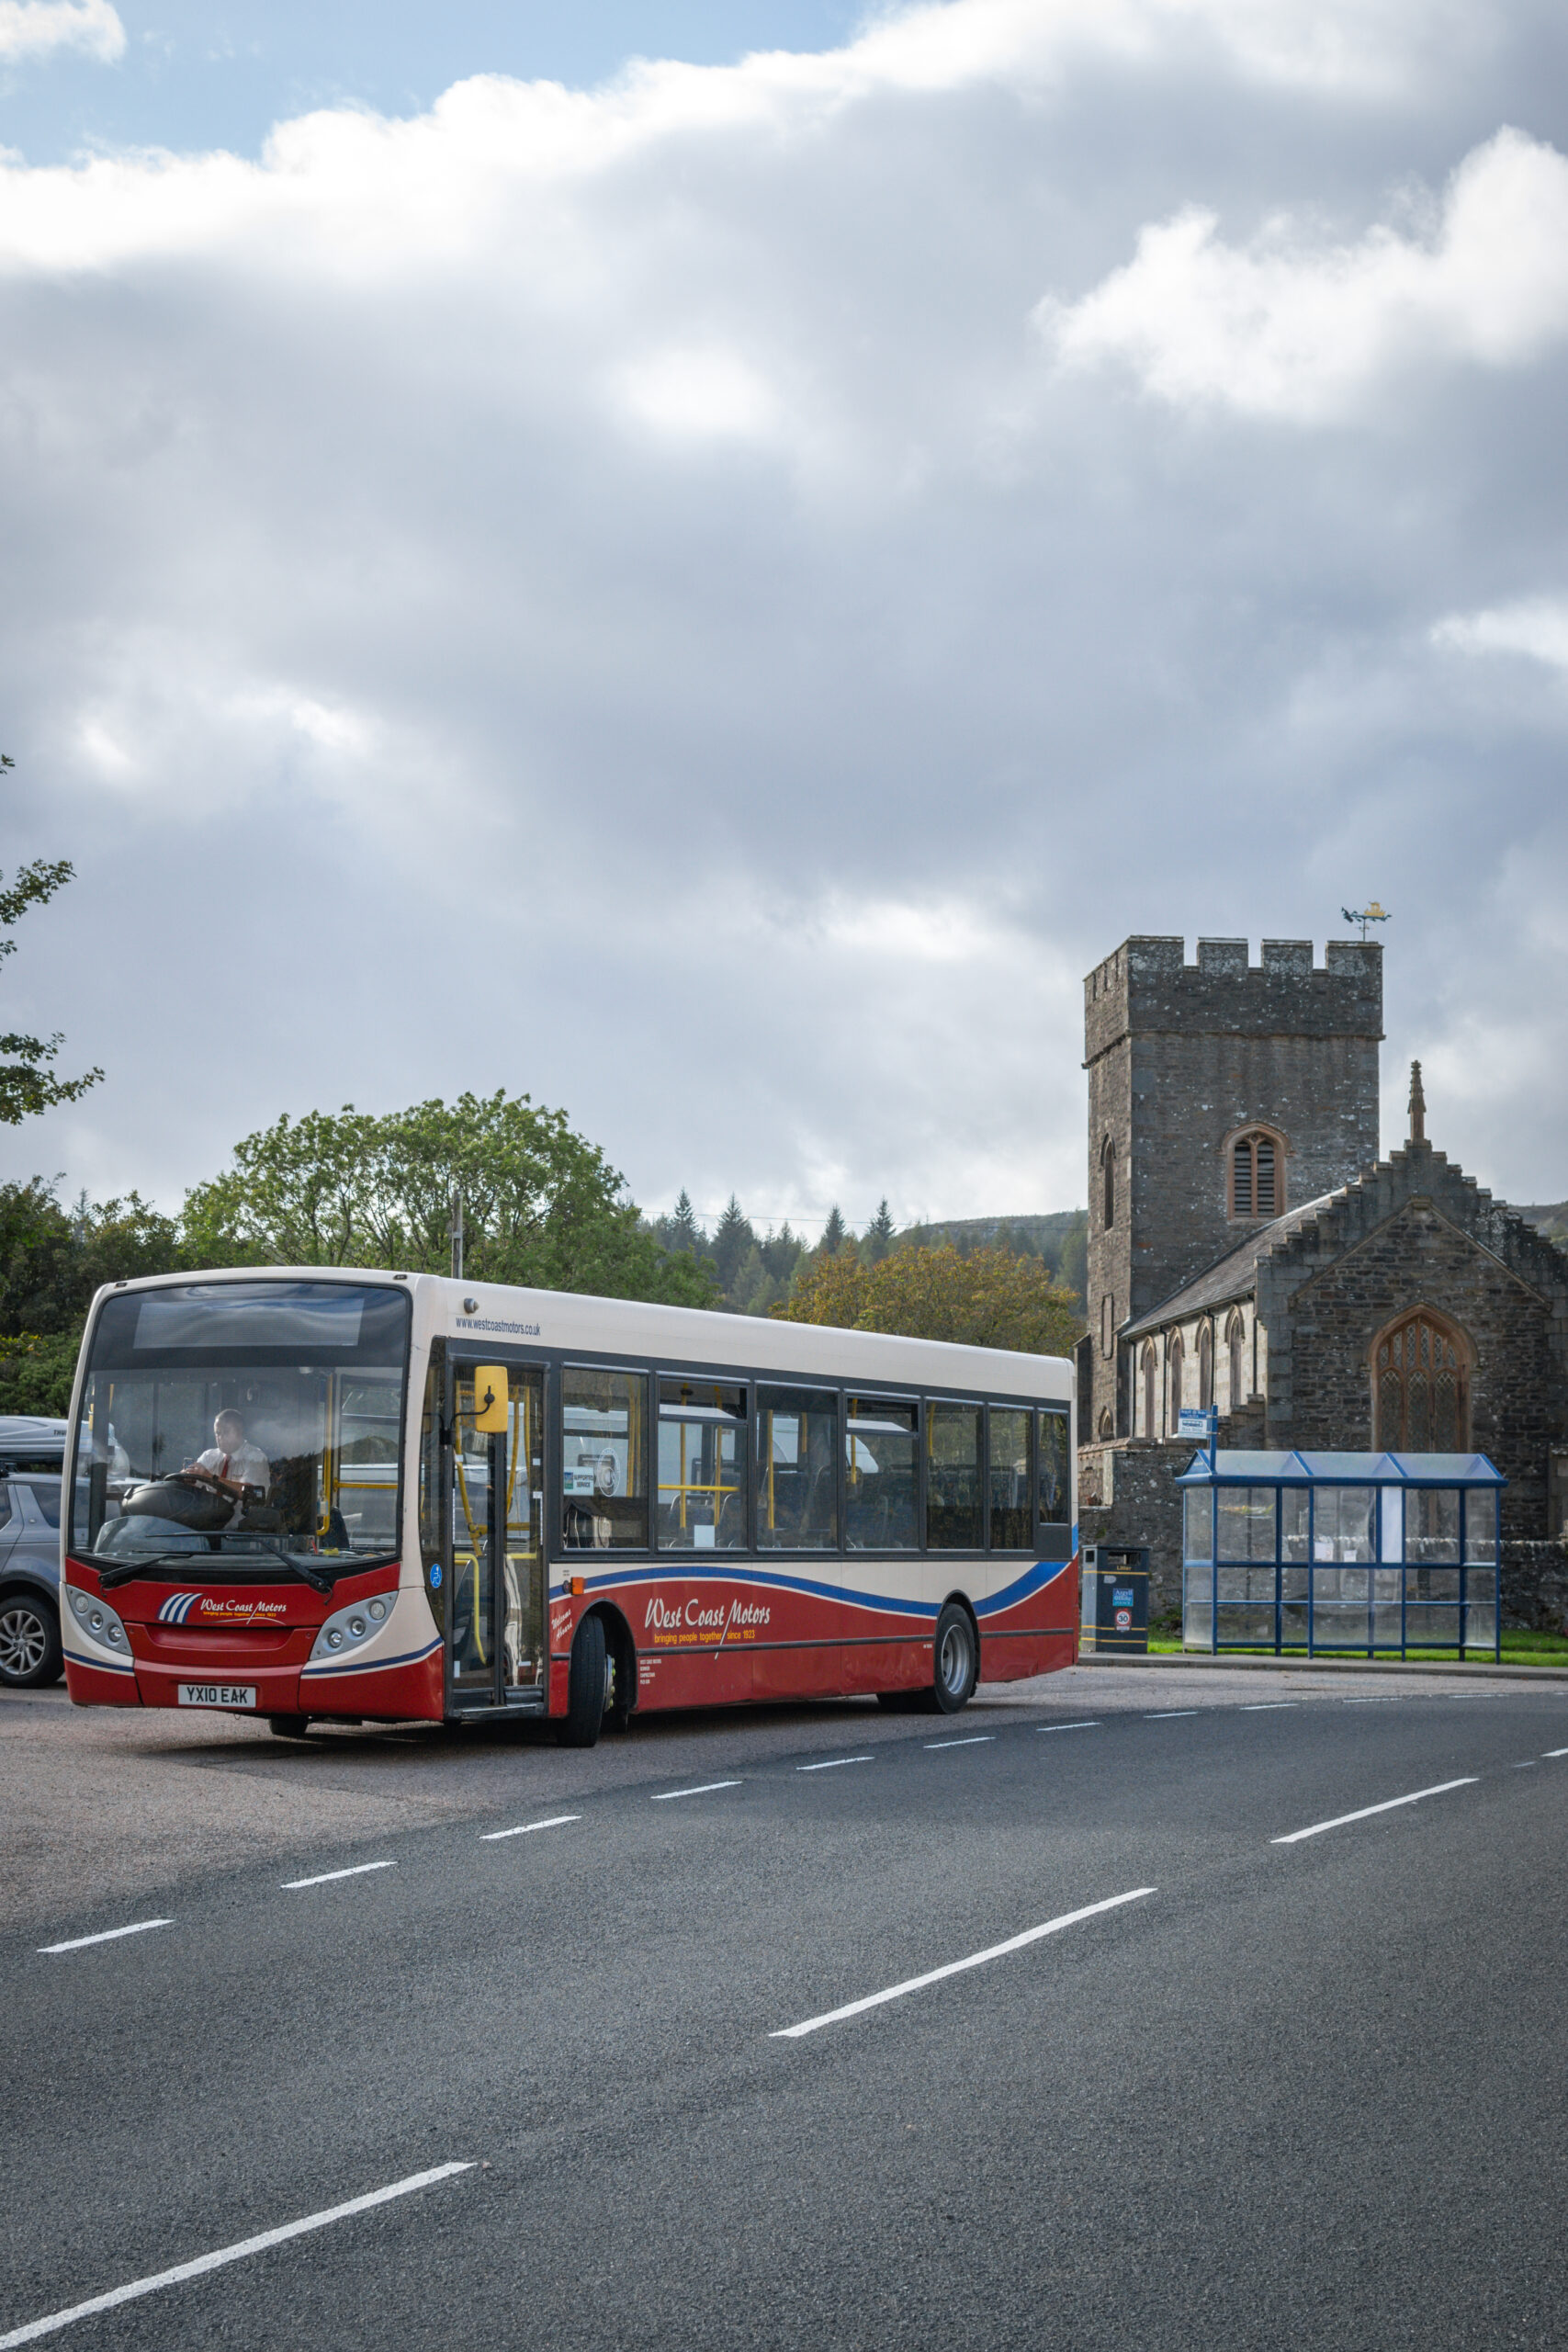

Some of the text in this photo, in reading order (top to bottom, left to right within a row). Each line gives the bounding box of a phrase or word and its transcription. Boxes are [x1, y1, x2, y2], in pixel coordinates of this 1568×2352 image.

[456, 1317, 541, 1336] www.westcoastmotors.co.uk
[200, 1599, 224, 1611] West
[226, 1600, 253, 1611] Coast
[645, 1599, 682, 1628] West
[685, 1599, 724, 1626] Coast
[654, 1630, 755, 1645] bringing people together since 1923
[186, 1687, 247, 1703] YX10 EAK
